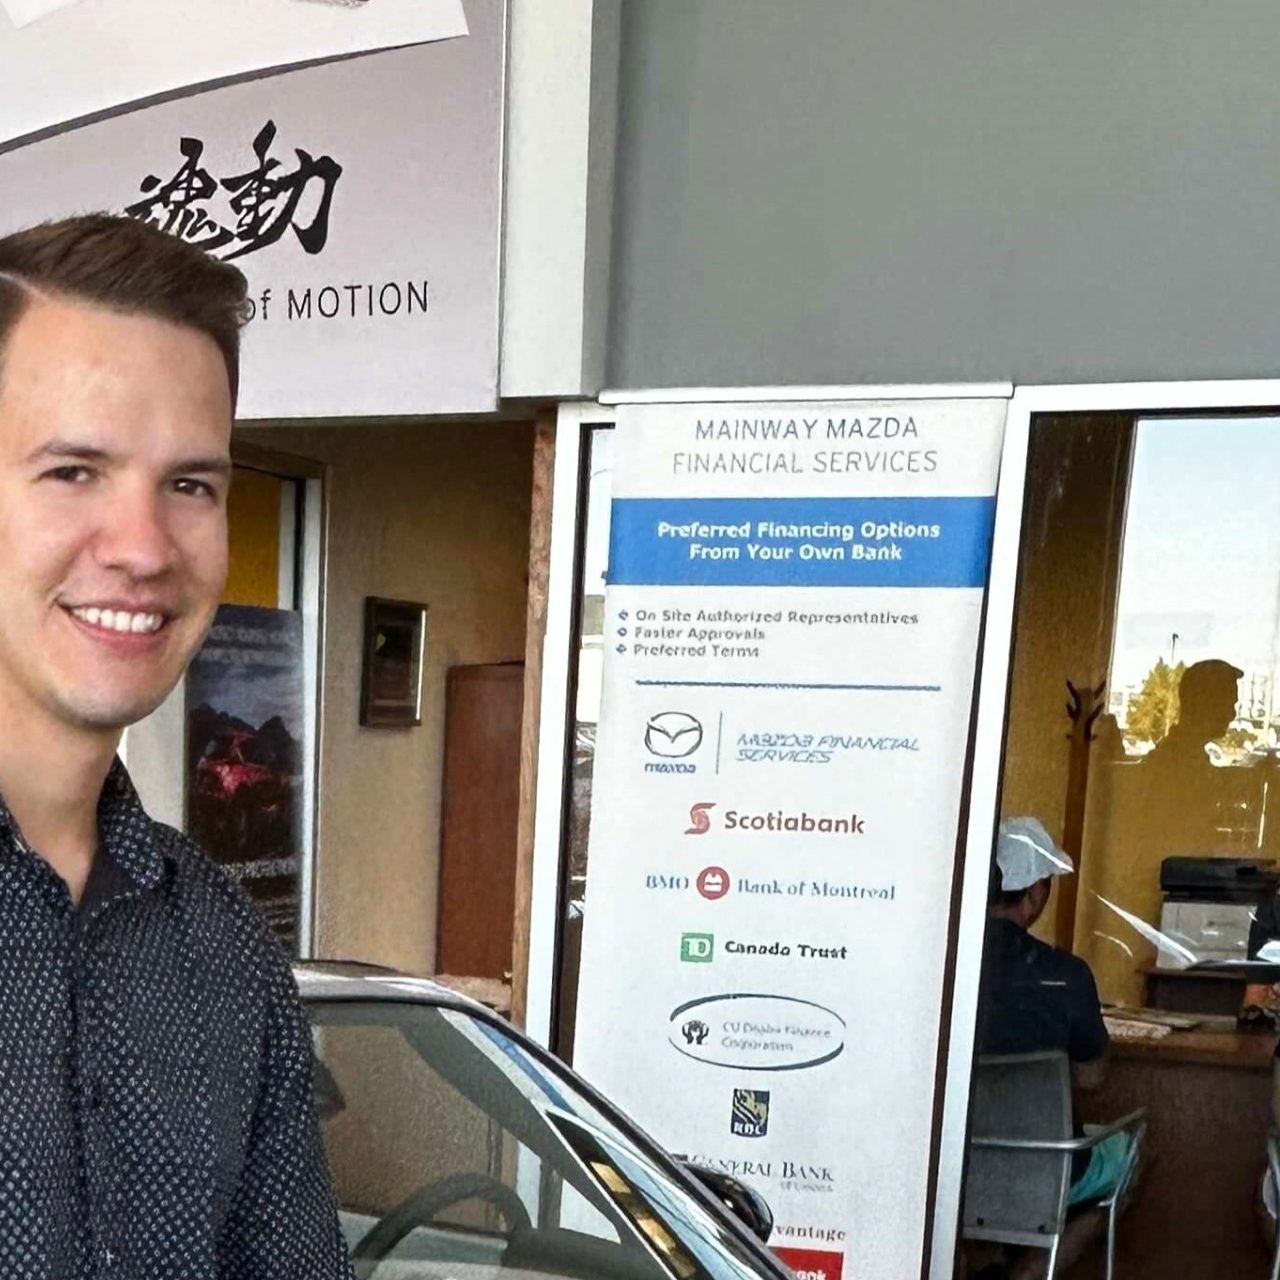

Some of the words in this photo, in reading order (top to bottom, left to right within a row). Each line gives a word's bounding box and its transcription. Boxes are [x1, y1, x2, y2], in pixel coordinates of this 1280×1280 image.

[288, 281, 429, 320] MOTION
[695, 418, 818, 440] MAINWAY
[826, 416, 919, 440] MAZDA
[673, 451, 803, 475] FINANCIAL
[813, 450, 938, 473] SERVICES
[658, 521, 751, 538] Preferred
[758, 522, 853, 540] Financing
[861, 522, 940, 540] Options
[690, 544, 740, 560] From
[747, 544, 793, 560] Your
[799, 544, 844, 560] Own
[852, 544, 902, 560] Bank
[636, 610, 656, 621] On
[663, 609, 691, 621] Site
[697, 609, 782, 623] Authorized
[688, 627, 765, 641] Approvals
[634, 643, 706, 657] Preferred
[725, 811, 865, 834] Scotiabank
[646, 875, 689, 890] BMO
[738, 879, 783, 895] Bank
[788, 880, 808, 896] of
[811, 882, 895, 900] Montreal
[684, 937, 711, 957] TD
[725, 940, 791, 957] Canada
[797, 944, 848, 960] Trust
[783, 1161, 835, 1182] BANK
[775, 1225, 846, 1242] vantage
